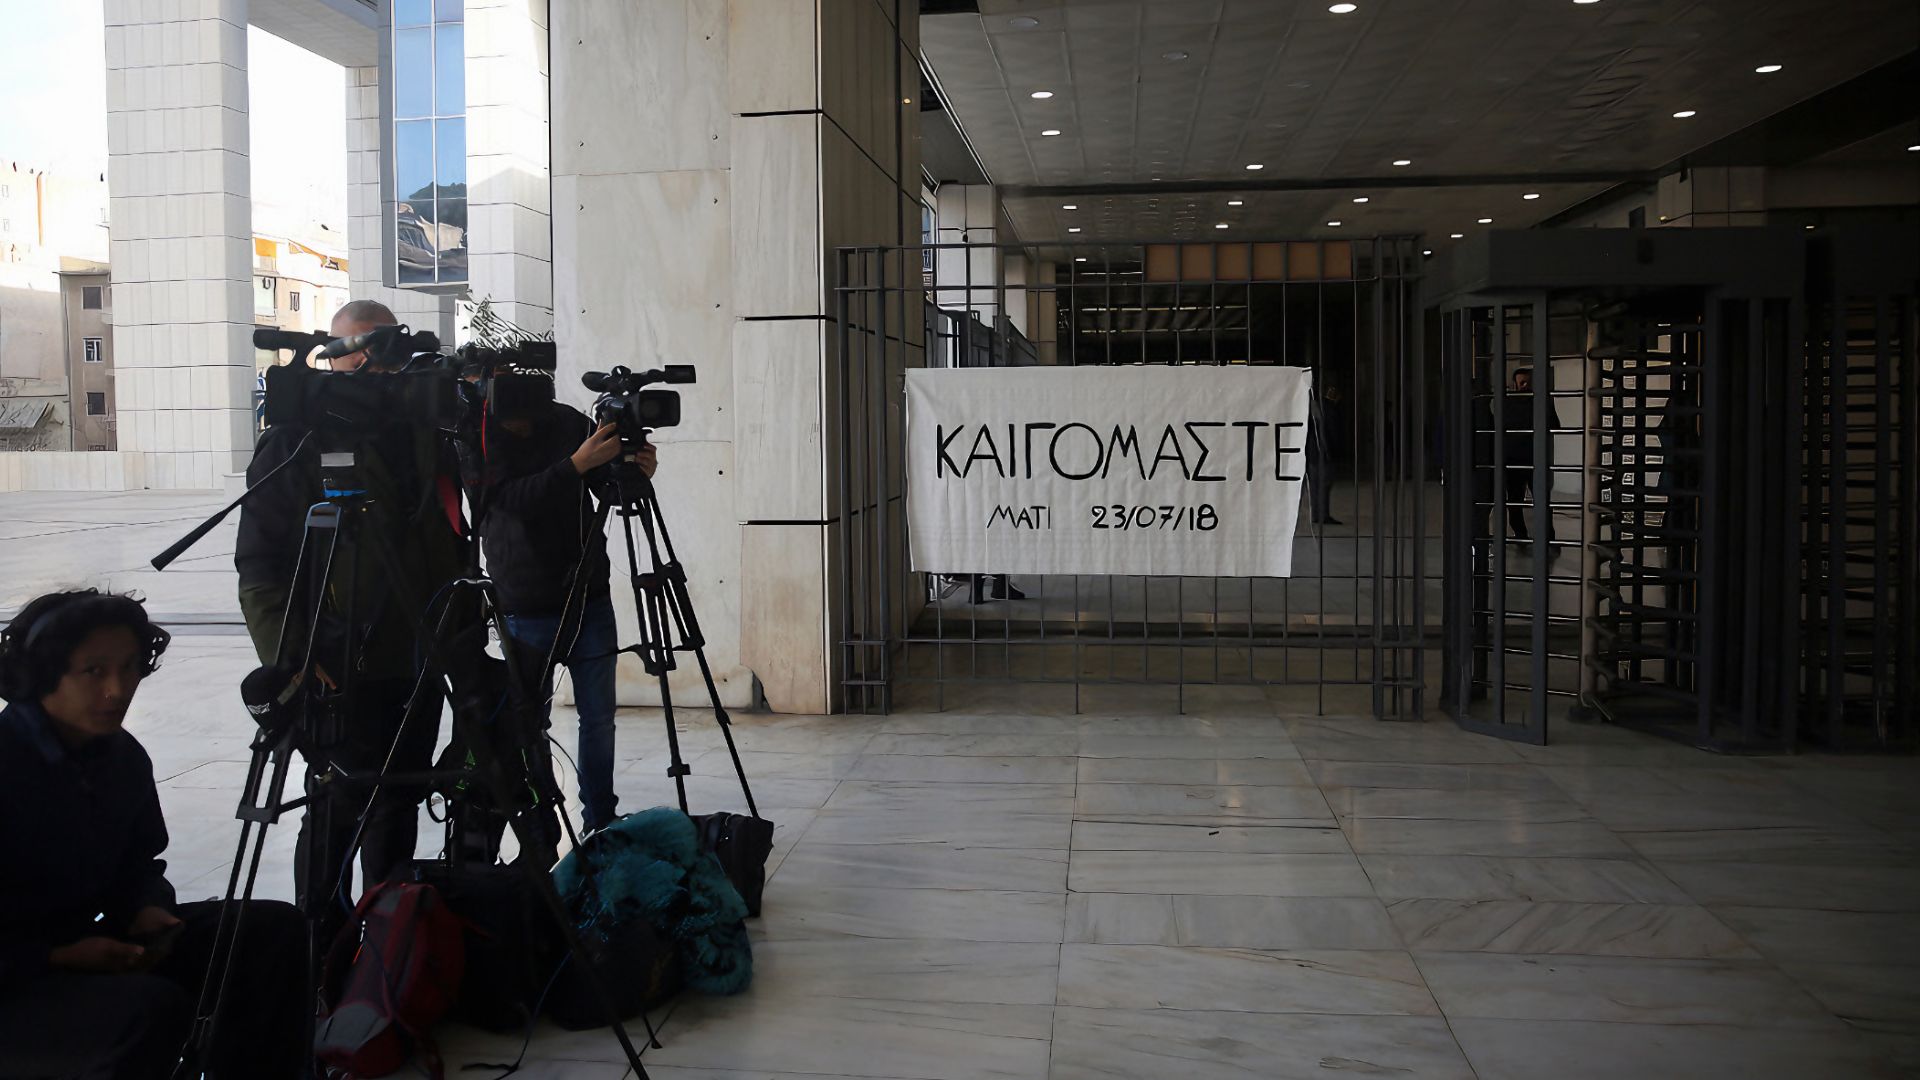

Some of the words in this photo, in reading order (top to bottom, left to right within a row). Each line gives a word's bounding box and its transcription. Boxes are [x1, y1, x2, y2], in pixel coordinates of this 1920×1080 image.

[936, 421, 1304, 482] ΚΑΙΓΟΜΑΣΤΕ
[986, 504, 1051, 530] ΜΑΤΙ
[1091, 503, 1219, 532] 23/07/18
